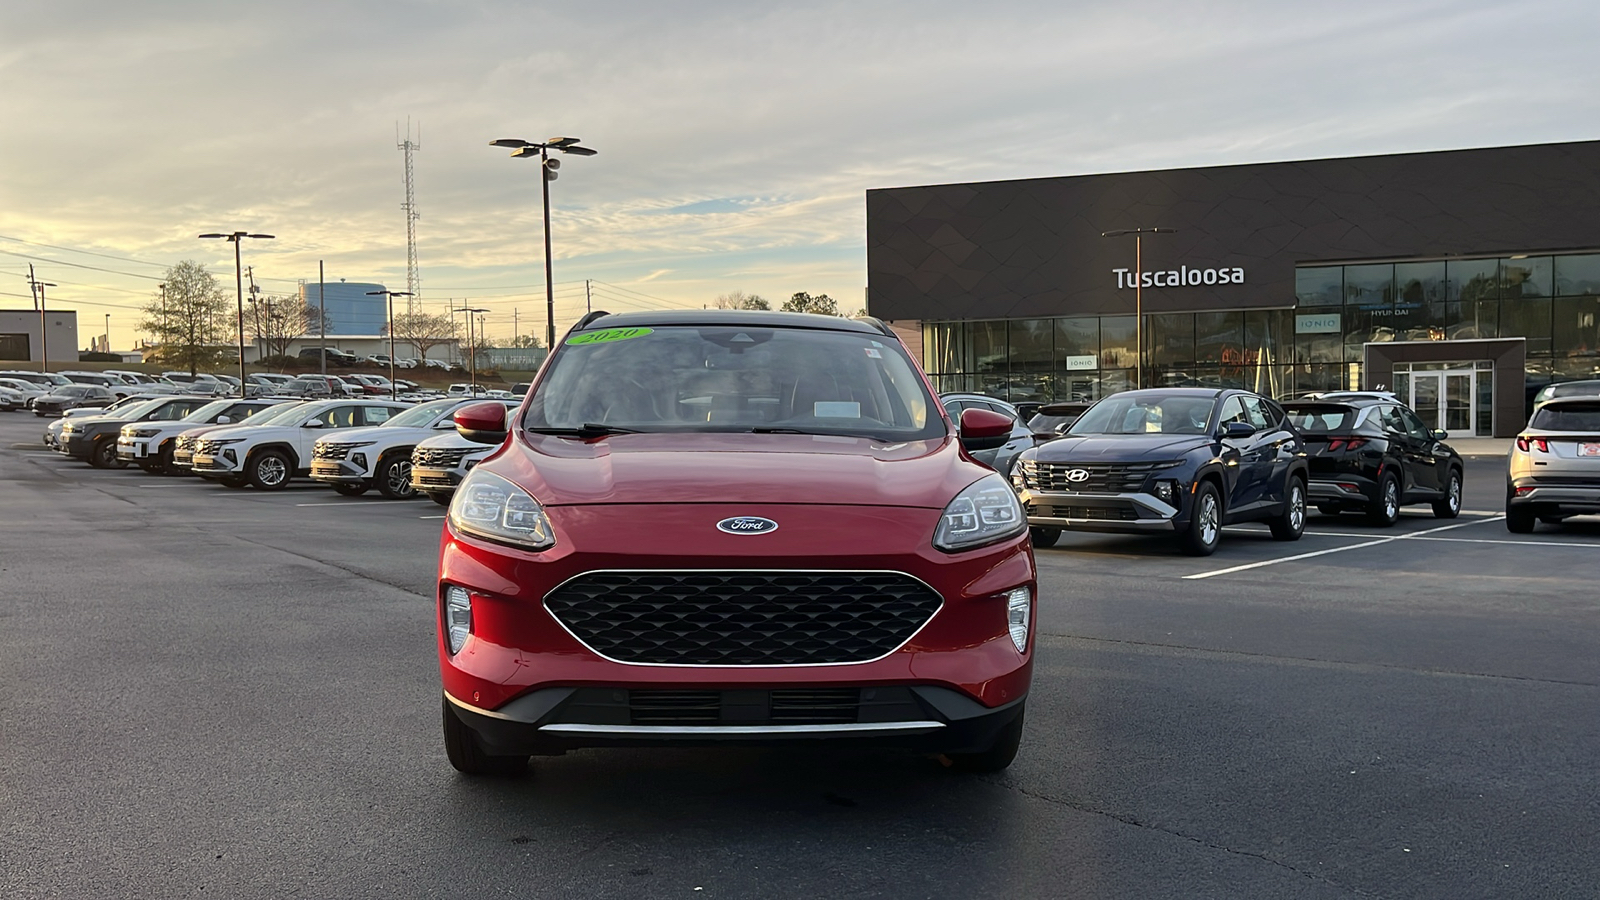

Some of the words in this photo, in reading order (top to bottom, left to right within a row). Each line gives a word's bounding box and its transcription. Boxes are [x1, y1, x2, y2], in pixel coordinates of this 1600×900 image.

[1112, 265, 1245, 289] Tuscaloosa
[579, 328, 639, 344] 2020
[731, 519, 764, 530] Ford
